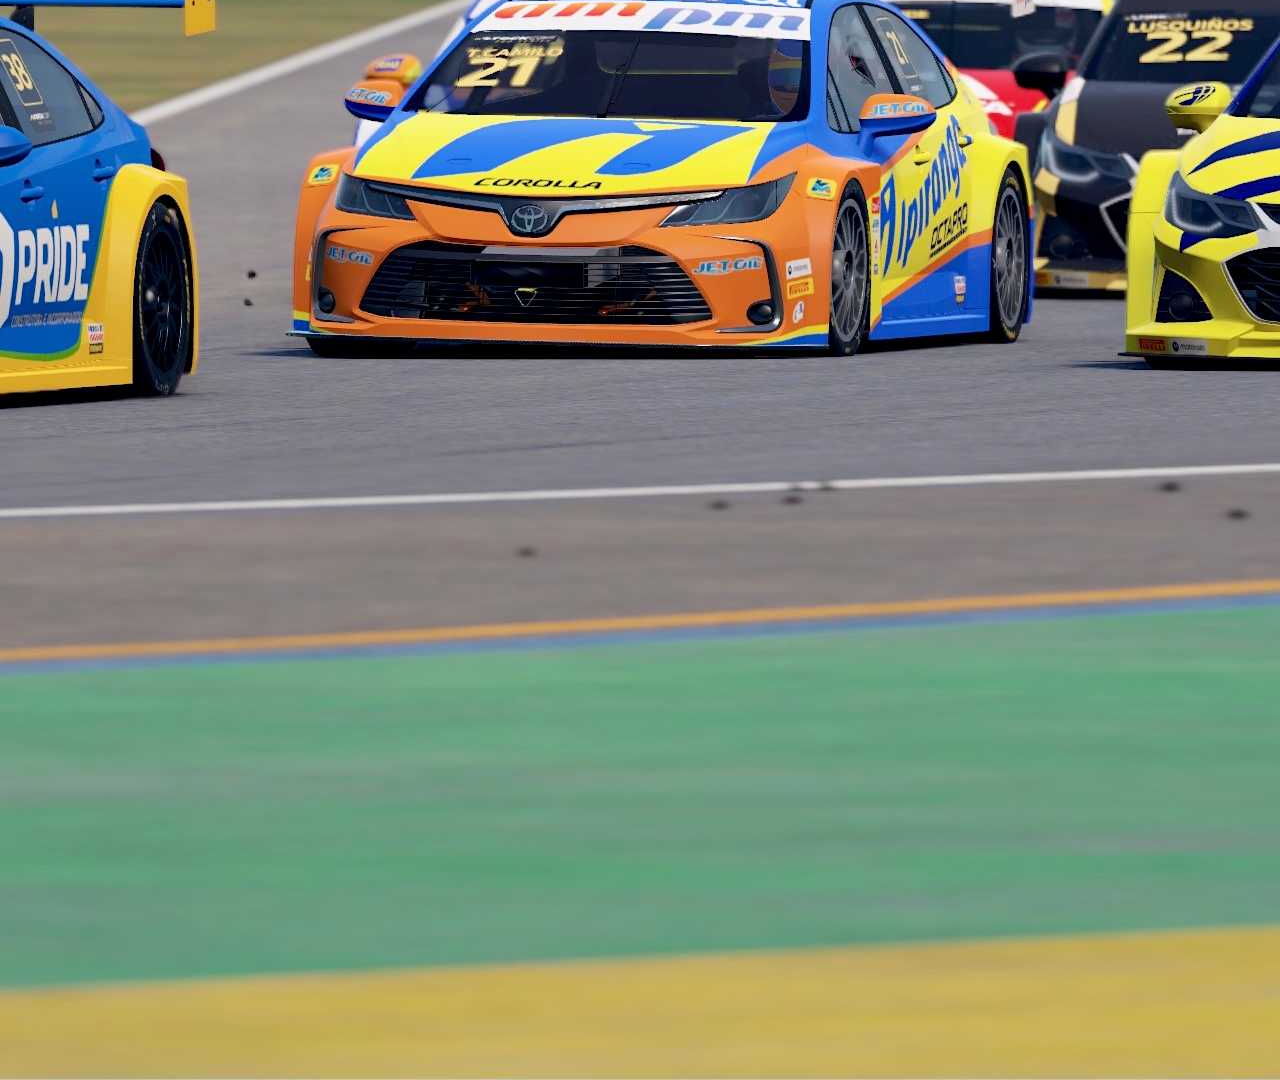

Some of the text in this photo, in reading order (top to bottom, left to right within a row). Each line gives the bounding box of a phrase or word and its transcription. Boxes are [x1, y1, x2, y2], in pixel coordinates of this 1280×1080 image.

[1138, 30, 1233, 63] 22
[454, 56, 541, 87] 21
[474, 176, 602, 190] COROLLA
[14, 199, 90, 306] PRIDE
